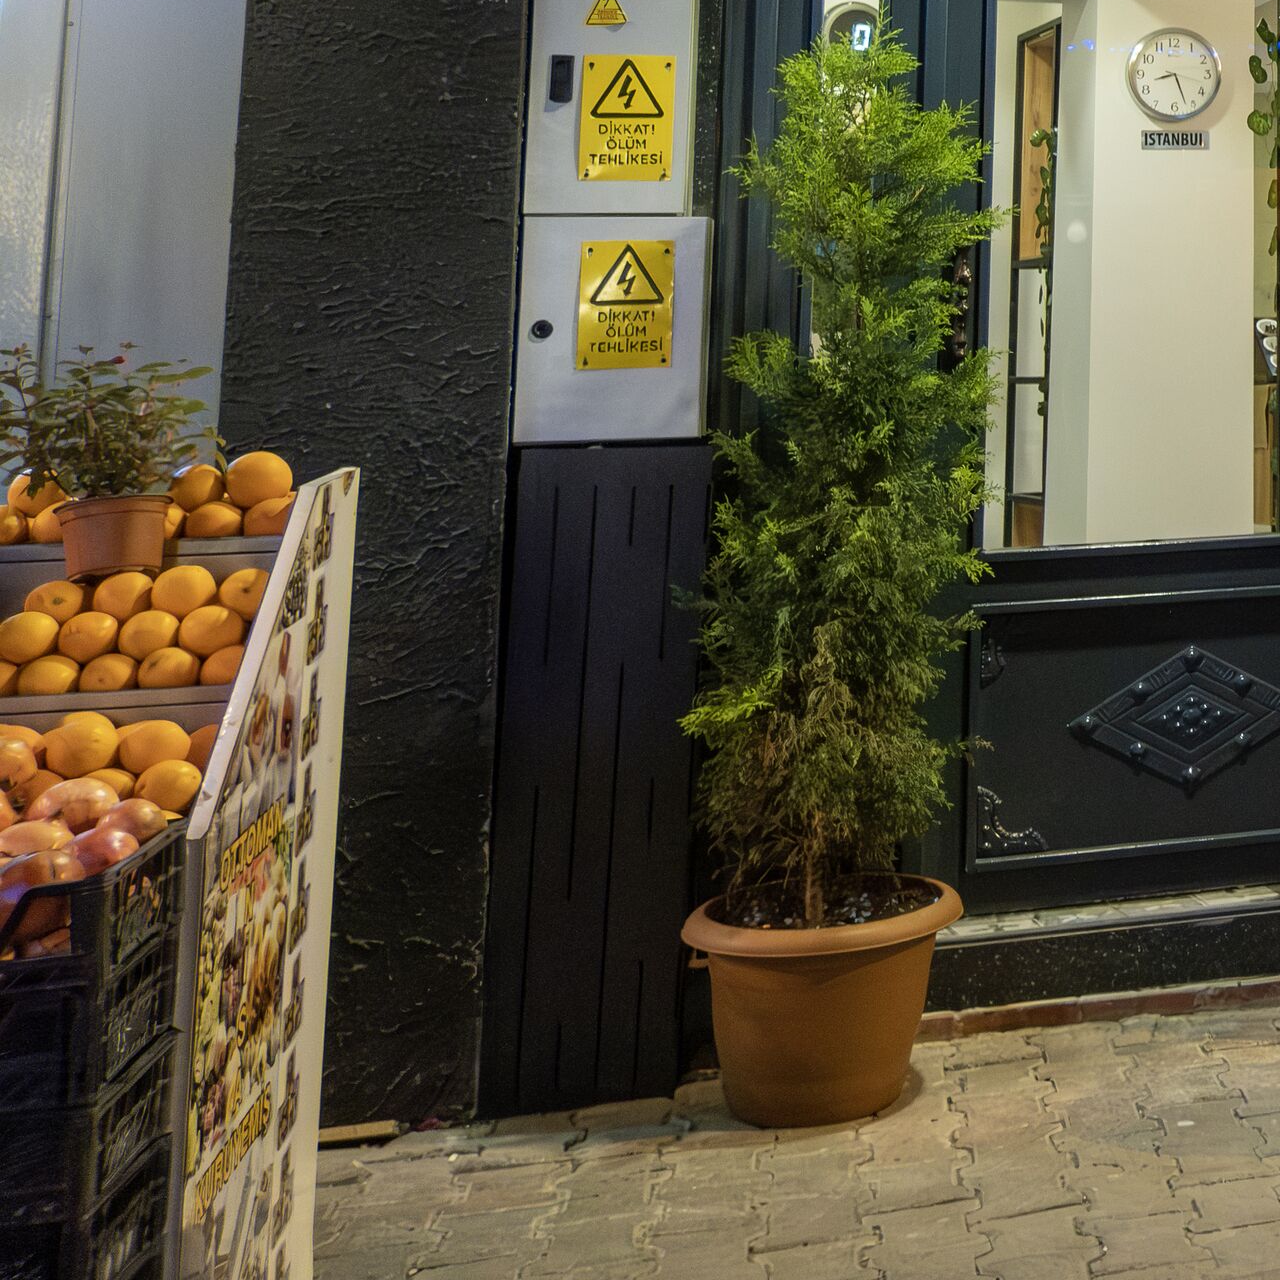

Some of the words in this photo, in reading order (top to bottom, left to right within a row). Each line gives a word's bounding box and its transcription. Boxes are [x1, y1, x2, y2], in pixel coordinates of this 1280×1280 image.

[1168, 38, 1180, 48] 12
[1143, 54, 1154, 64] 10
[1200, 55, 1207, 64] 2
[1137, 70, 1145, 79] 9
[1203, 69, 1211, 80] 3
[1142, 85, 1150, 95] 8
[1197, 86, 1204, 96] 4
[1170, 102, 1179, 112] 6
[598, 121, 655, 135] DİKKAT!
[606, 136, 646, 150] ÖLÜM
[589, 151, 662, 165] TEHLİKESİ
[597, 308, 655, 323] DİKKAT!
[606, 323, 647, 338] ÖLÜM
[589, 336, 663, 352] TEHLİKESİ
[220, 793, 285, 893] OTTOMAN
